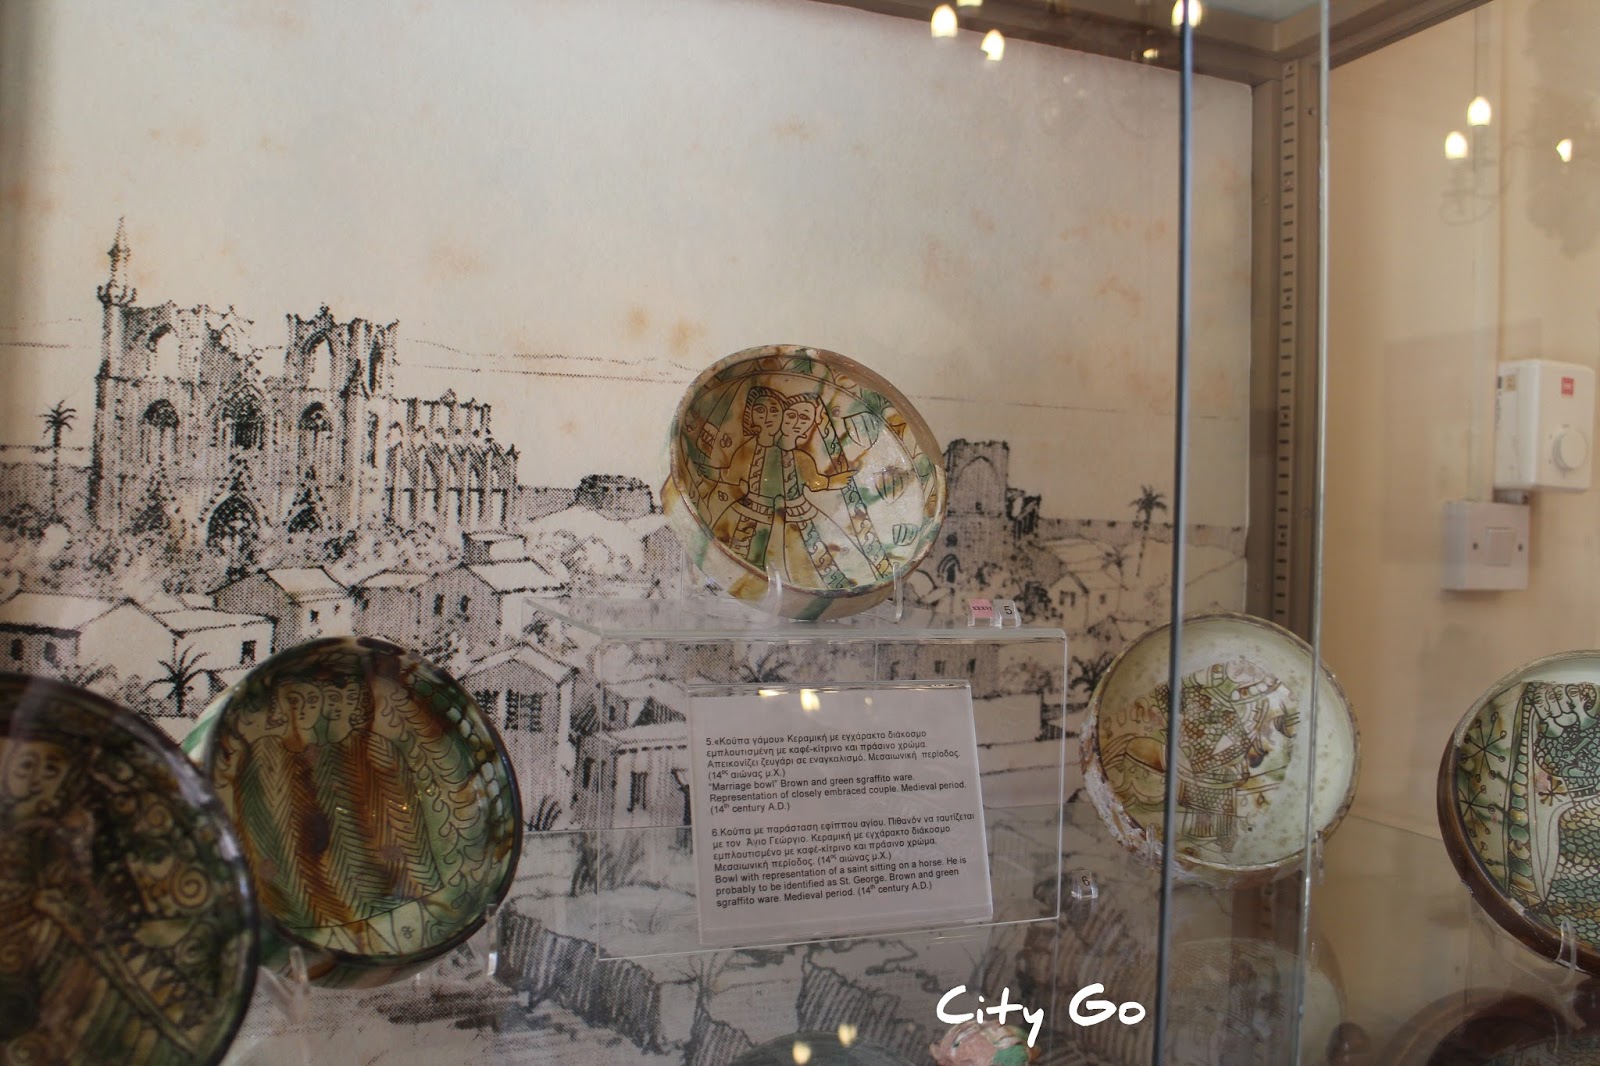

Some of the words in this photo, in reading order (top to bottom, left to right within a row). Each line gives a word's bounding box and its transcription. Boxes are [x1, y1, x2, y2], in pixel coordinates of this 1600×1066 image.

[1003, 605, 1013, 615] 5
[787, 733, 827, 744] Κεραμική
[841, 732, 885, 743] εγχάρακτο
[888, 731, 926, 740] διάκοσμο
[706, 748, 774, 758] εμπλουτισμένη
[776, 746, 787, 755] με
[789, 745, 842, 754] καφέ-κίτρινο
[860, 742, 895, 752] πράσινο
[707, 759, 759, 769] Απεικονίζει
[761, 757, 794, 767] ζευγάρι
[796, 757, 807, 765] σε
[809, 755, 865, 764] εναγκαλισμό.
[868, 752, 917, 761] Μεσαιωνική
[921, 750, 960, 759] περίοδος.
[731, 770, 762, 779] αιώνας
[780, 779, 808, 788] Brown
[811, 778, 827, 786] and
[830, 777, 853, 787] green
[856, 775, 891, 785] sgraffito
[710, 791, 778, 803] Representation
[780, 790, 789, 799] of
[791, 789, 821, 798] closely
[825, 787, 866, 796] embraced
[869, 784, 899, 794] couple.
[901, 782, 937, 792] Medieval
[939, 781, 966, 791] period.
[732, 803, 765, 813] century
[768, 801, 790, 811] A.D.)
[754, 827, 764, 835] με
[767, 823, 818, 834] παράσταση
[821, 821, 858, 831] εφίππου
[861, 819, 885, 829] αγίου.
[888, 816, 921, 825] Πιθανόν
[924, 815, 933, 823] να
[936, 813, 974, 822] ταυτίζεται
[713, 842, 723, 850] με
[726, 840, 741, 848] τον
[769, 836, 808, 845] Γεώργιο.
[811, 832, 852, 842] Κεραμική
[854, 831, 863, 840] με
[865, 829, 909, 839] εγχάρακτο
[912, 825, 950, 835] διάκοσμο
[713, 849, 781, 861] εμπλουτισμένο
[784, 848, 794, 856] με
[797, 844, 851, 855] καφέ-κίτρινο
[869, 840, 904, 850] πράσινο
[714, 861, 768, 872] Μεσαιωνική
[771, 858, 815, 868] περίοδος.
[839, 853, 870, 863] αιώνας
[715, 873, 738, 883] Bowl
[741, 872, 759, 881] with
[762, 868, 826, 881] representation
[847, 864, 868, 874] saint
[870, 862, 896, 872] sitting
[946, 857, 957, 865] He
[716, 884, 756, 897] probably
[758, 884, 767, 892] to
[770, 882, 781, 890] be
[784, 879, 824, 890] identified
[839, 877, 850, 885] St.
[853, 875, 887, 885] George.
[889, 873, 915, 881] Brown
[918, 869, 933, 878] and
[936, 869, 959, 878] green
[1081, 875, 1090, 886] 6
[716, 896, 755, 908] sgraffito
[757, 896, 781, 904] ware.
[784, 890, 823, 901] Medieval
[825, 888, 855, 899] period.
[878, 884, 909, 894] century
[911, 881, 932, 890] A.D.)
